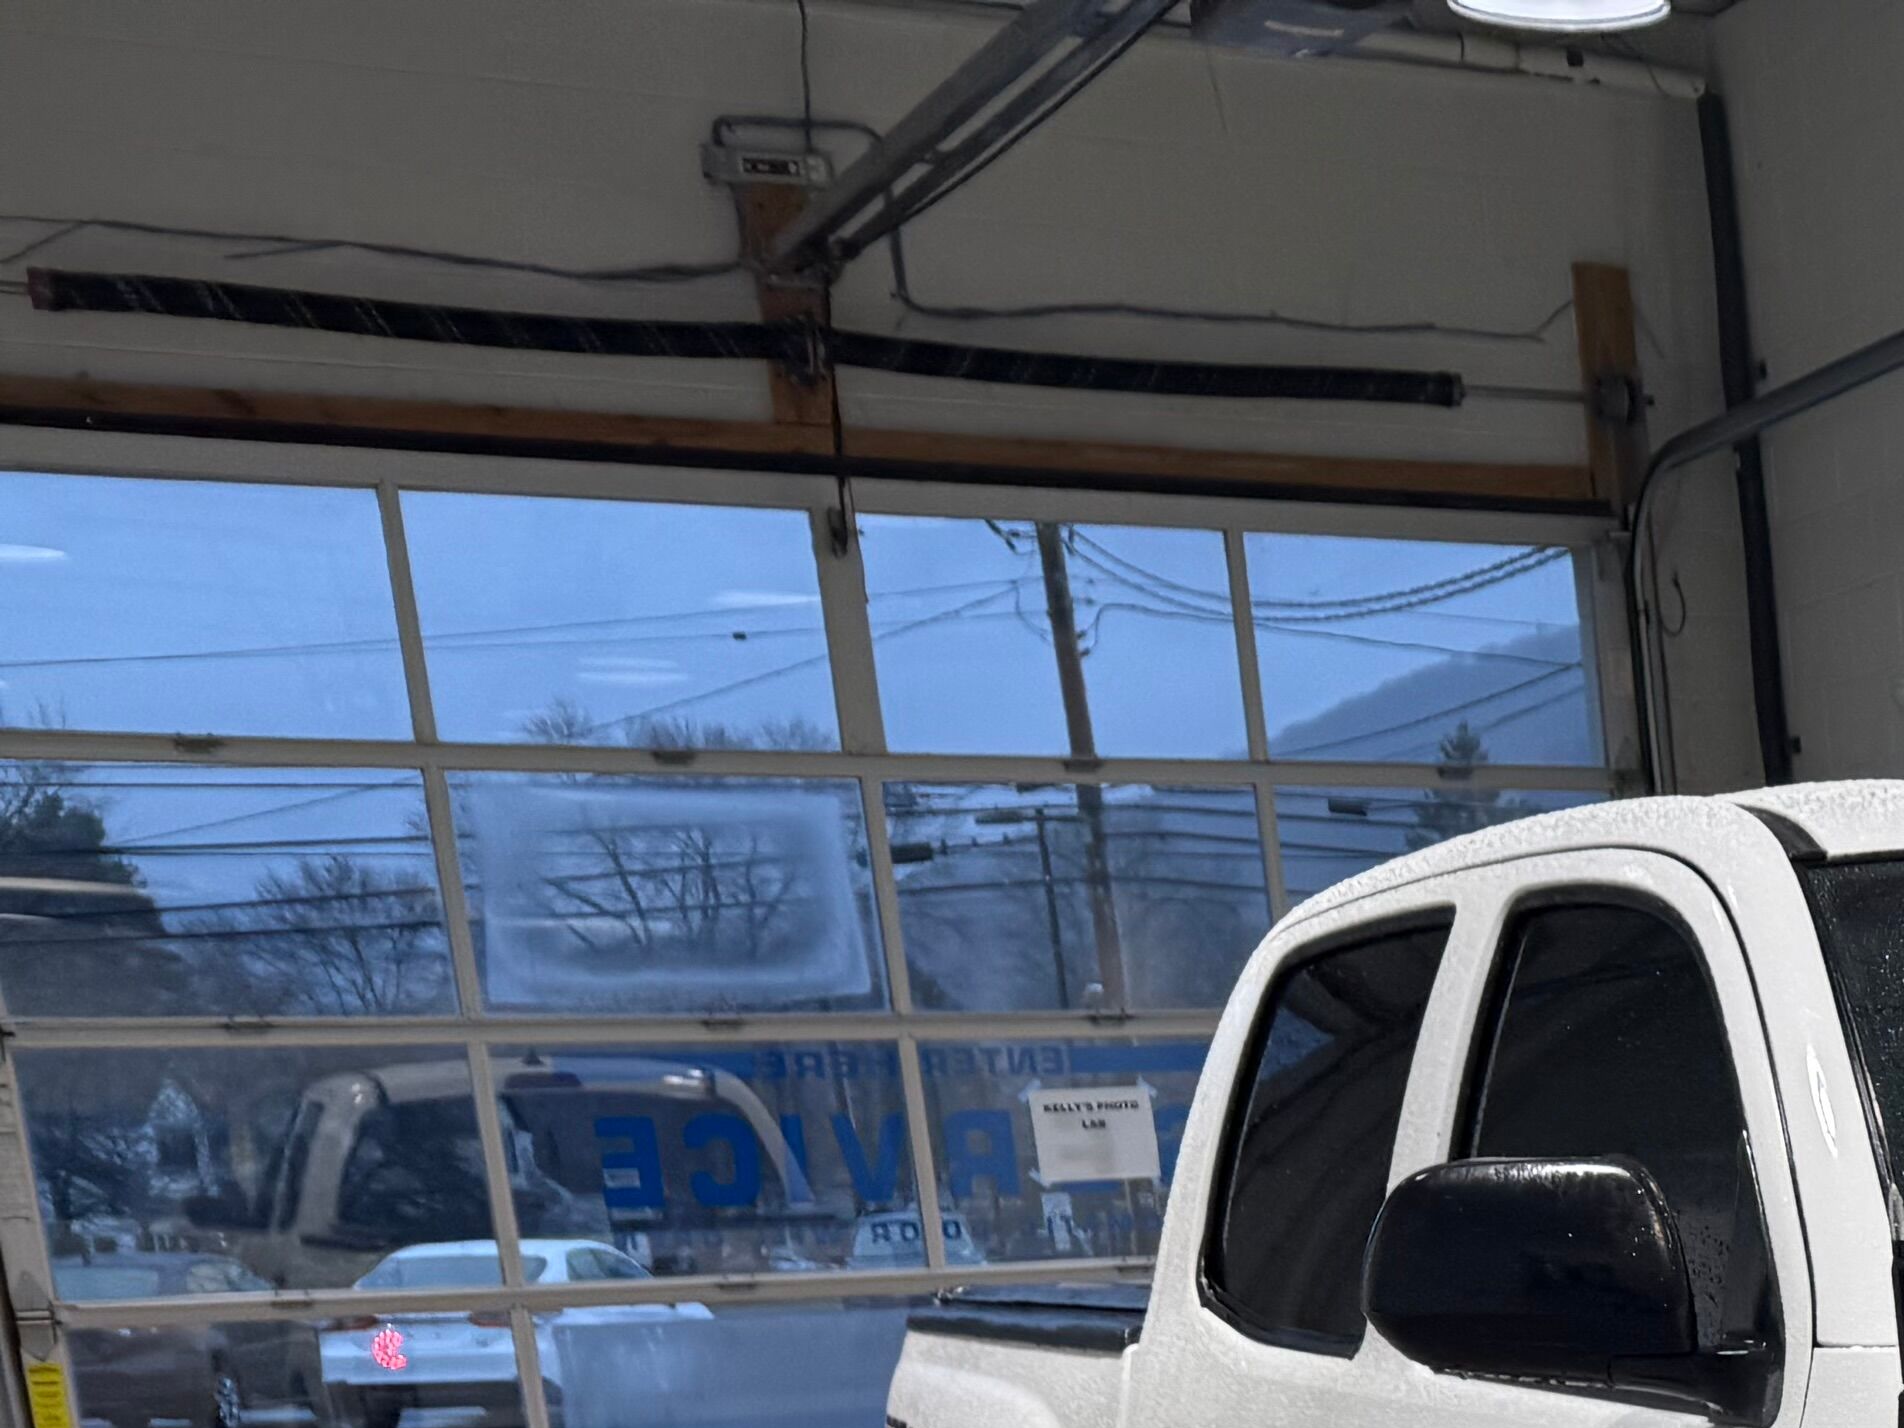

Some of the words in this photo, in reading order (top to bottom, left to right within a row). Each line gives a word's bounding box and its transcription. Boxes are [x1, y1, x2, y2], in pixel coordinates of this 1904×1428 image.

[1043, 1102, 1094, 1113] KELLY'S
[1096, 1100, 1140, 1110] PHOTO
[1082, 1119, 1106, 1129] LAB
